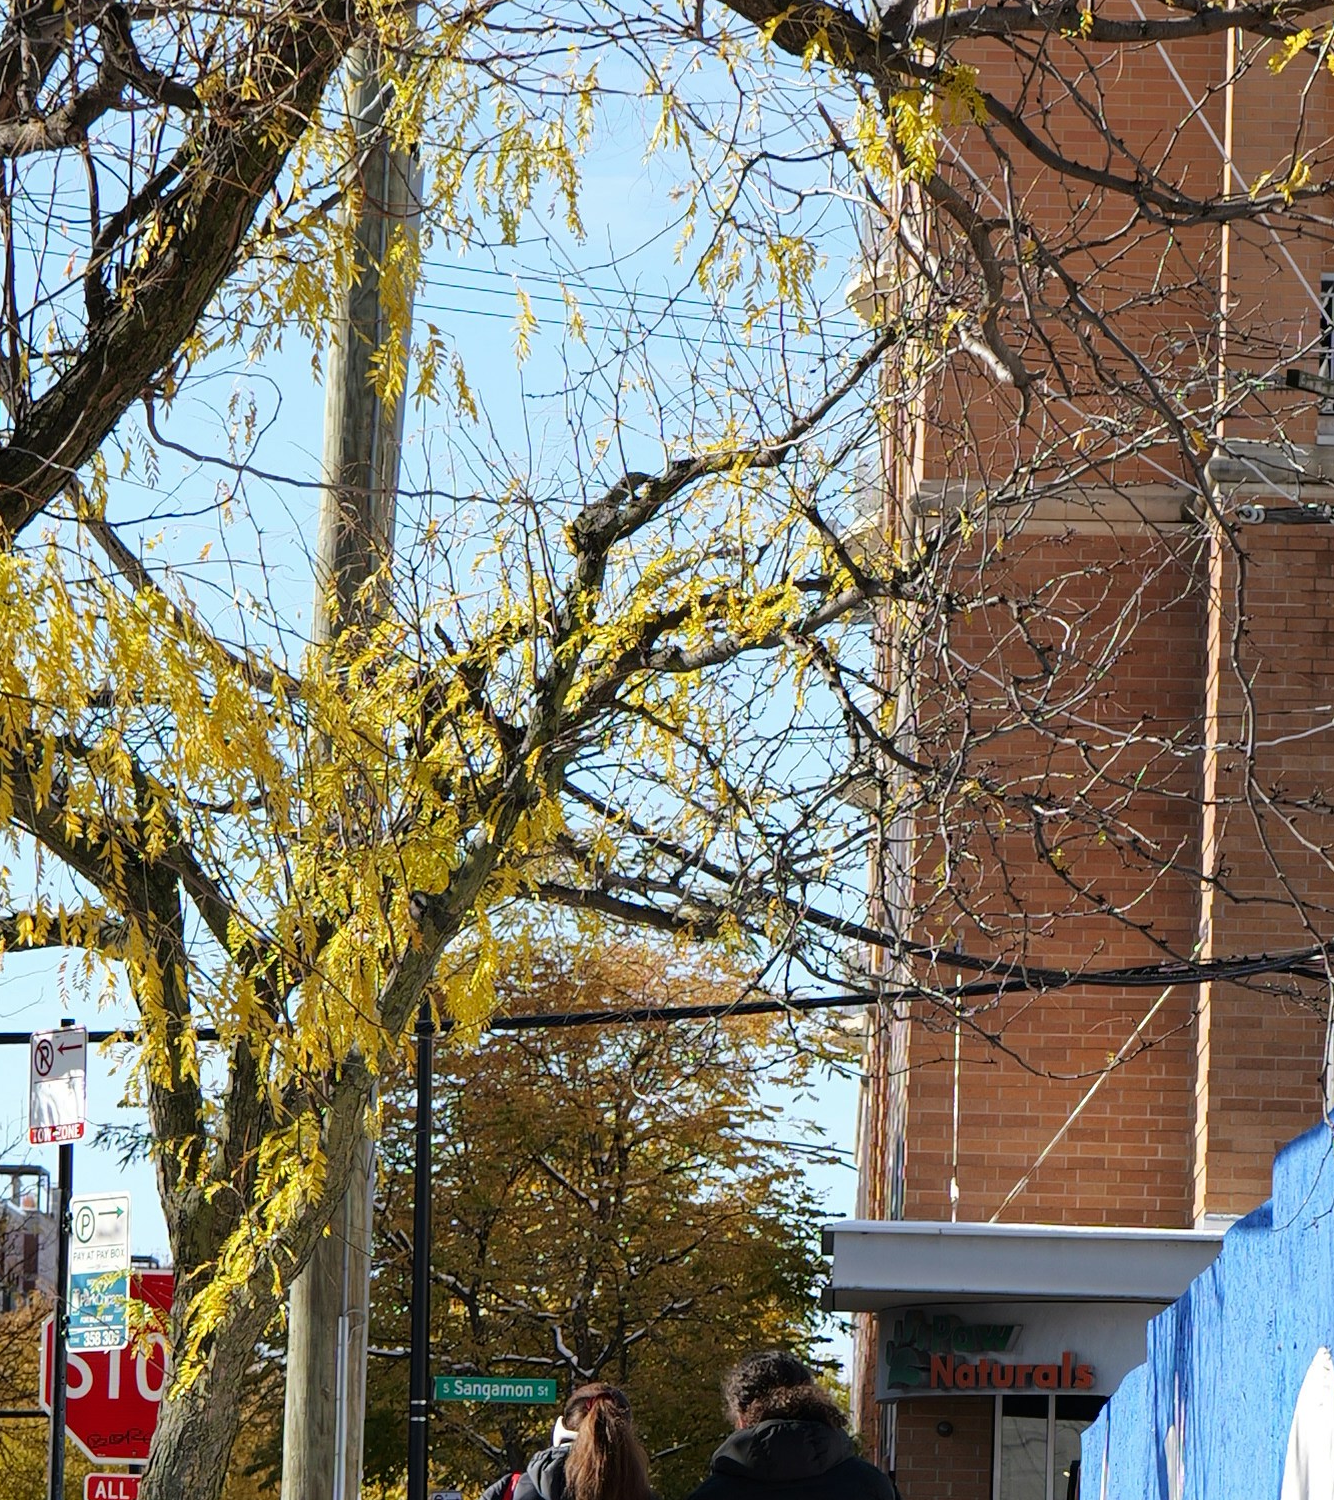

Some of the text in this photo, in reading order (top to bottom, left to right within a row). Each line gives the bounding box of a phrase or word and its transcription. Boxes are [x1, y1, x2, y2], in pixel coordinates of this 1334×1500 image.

[73, 1248, 124, 1261] PAY AT PAY BOX
[83, 1331, 101, 1347] 358
[932, 1313, 1020, 1351] Paw
[930, 1351, 1095, 1389] Naturals
[443, 1379, 549, 1401] S Sangamon St
[94, 1480, 130, 1500] ALL
